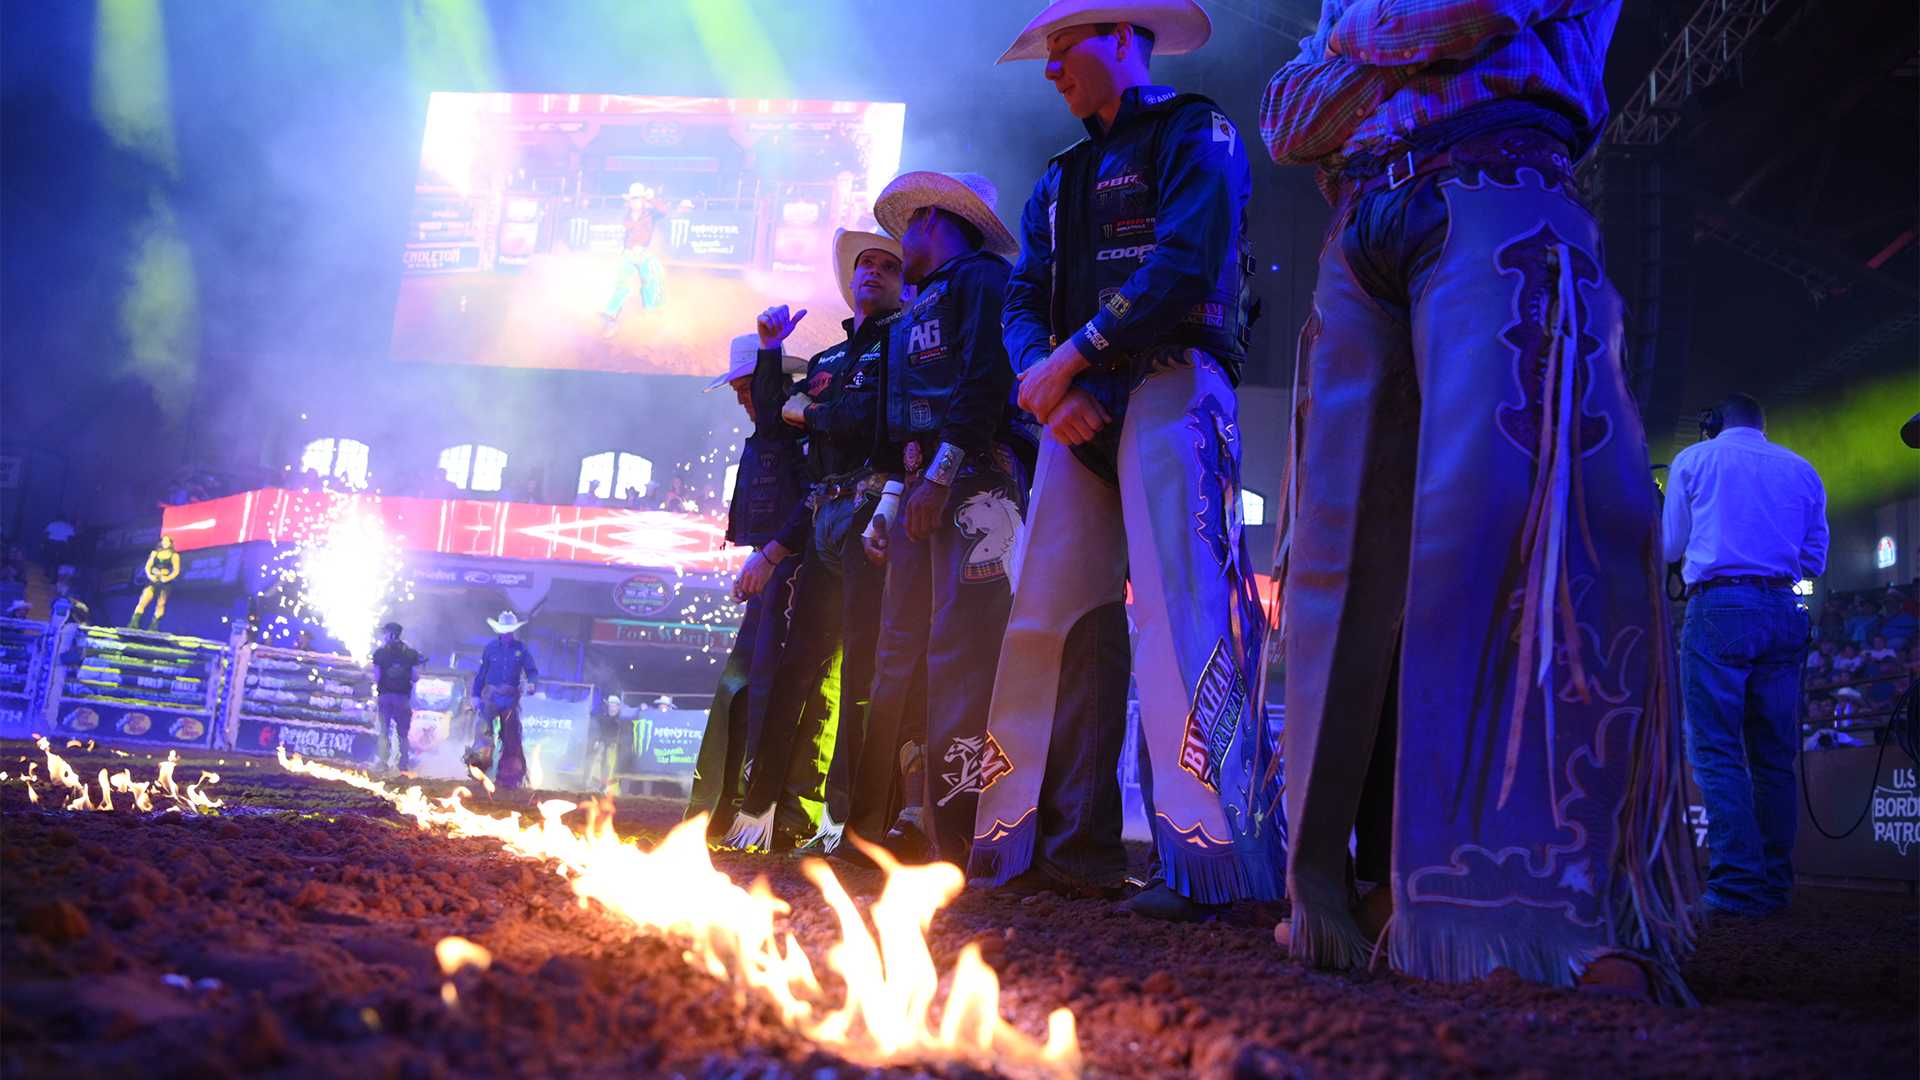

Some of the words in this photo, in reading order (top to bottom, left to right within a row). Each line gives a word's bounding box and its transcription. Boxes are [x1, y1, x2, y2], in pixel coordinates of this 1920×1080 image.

[1096, 175, 1138, 191] PBR
[1096, 244, 1158, 260] COOP
[654, 726, 703, 739] MONSTER
[1874, 797, 1920, 817] BORD
